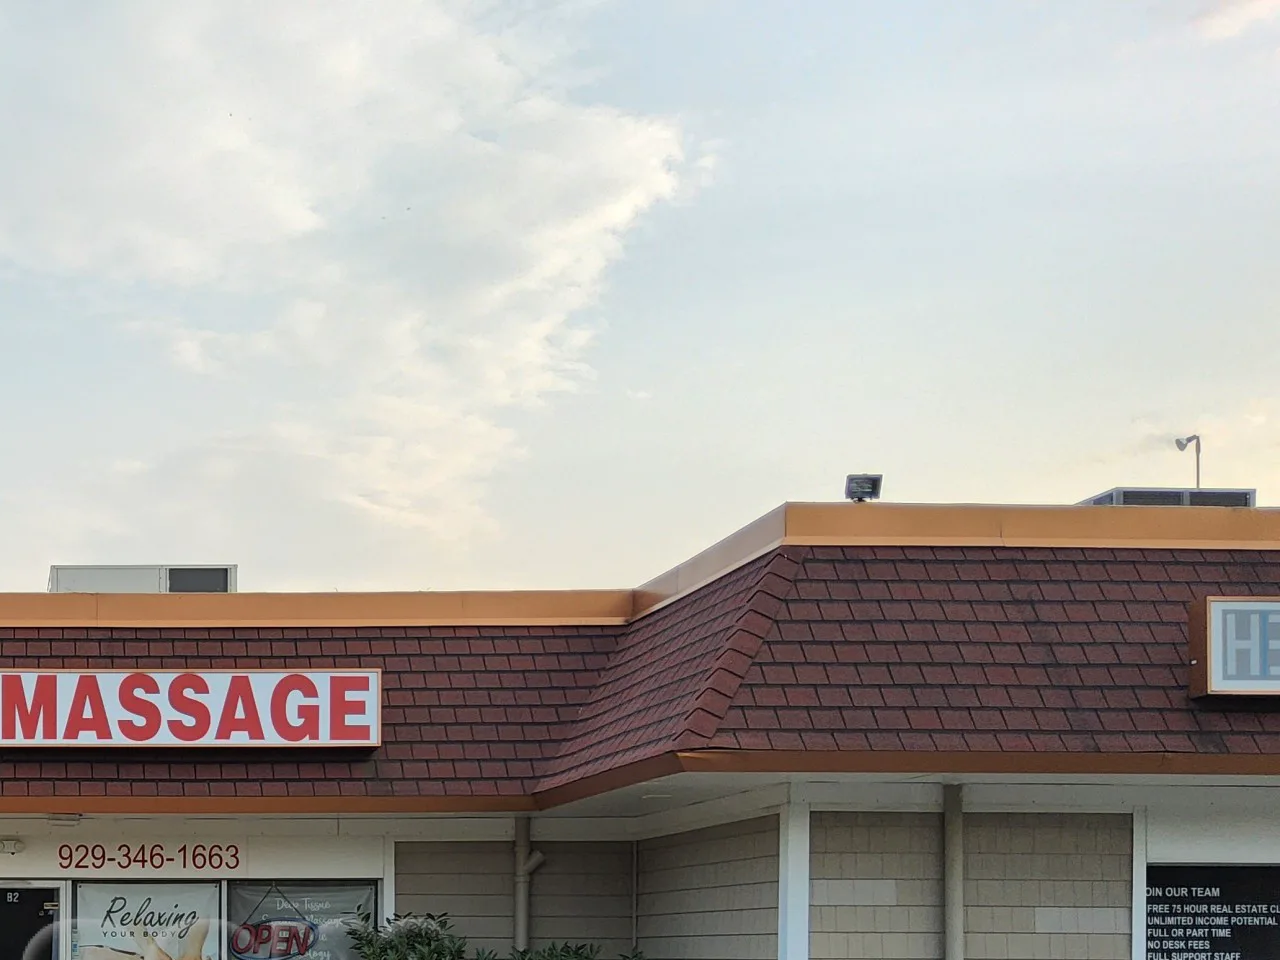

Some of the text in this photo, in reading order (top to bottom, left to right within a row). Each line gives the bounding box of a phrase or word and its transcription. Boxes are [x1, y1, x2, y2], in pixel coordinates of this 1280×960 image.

[1, 672, 371, 742] MASSAGE
[57, 844, 241, 870] 929-346-1663
[7, 892, 20, 902] B2
[1145, 887, 1220, 897] OIN OUR TEAM
[1147, 904, 1170, 913] FREE
[1171, 904, 1182, 913] 75
[1183, 904, 1208, 913] HOUR
[1210, 904, 1233, 913] REAL
[1235, 904, 1268, 913] ESTATE
[101, 896, 199, 939] Relaxing
[1147, 916, 1278, 926] UNLIMITED INCOME POTENTIAL
[1147, 928, 1231, 937] FULL OR PART TIME
[232, 924, 311, 956] OPEN
[1147, 940, 1210, 949] NO DESK FEES
